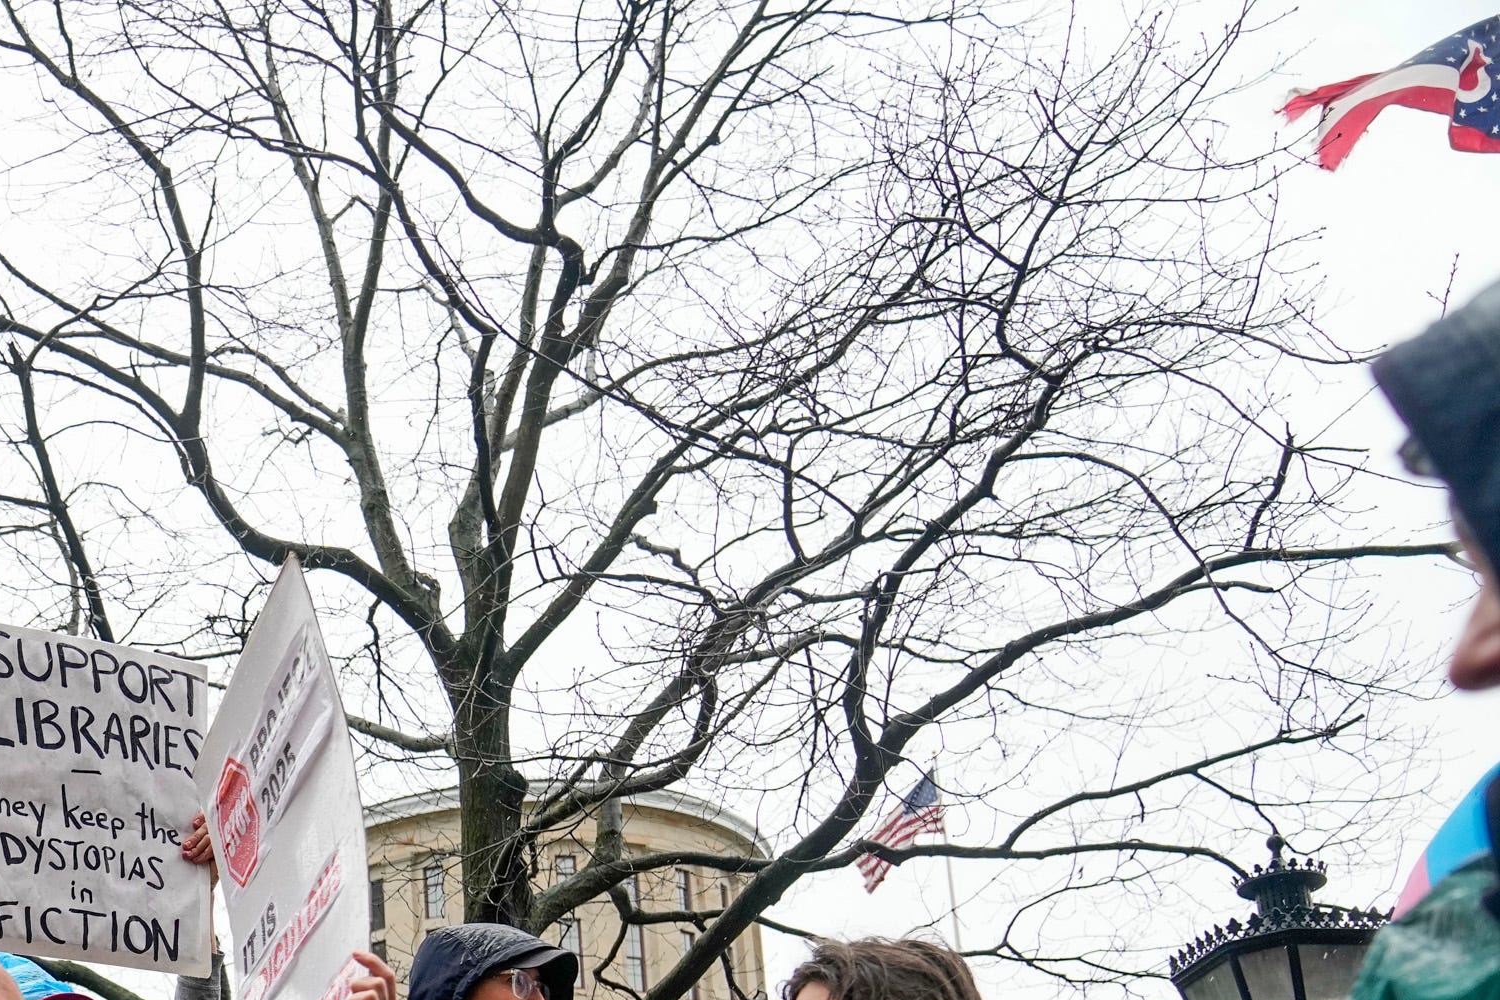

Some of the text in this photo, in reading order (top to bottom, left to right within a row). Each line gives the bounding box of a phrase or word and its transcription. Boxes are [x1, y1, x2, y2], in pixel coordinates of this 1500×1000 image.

[61, 784, 125, 840] keep
[136, 802, 182, 847] the
[261, 742, 297, 823] 2025
[224, 786, 251, 858] STOP
[0, 832, 164, 890] DYSTOPIAS
[70, 881, 93, 904] in
[243, 901, 277, 976] IT IS
